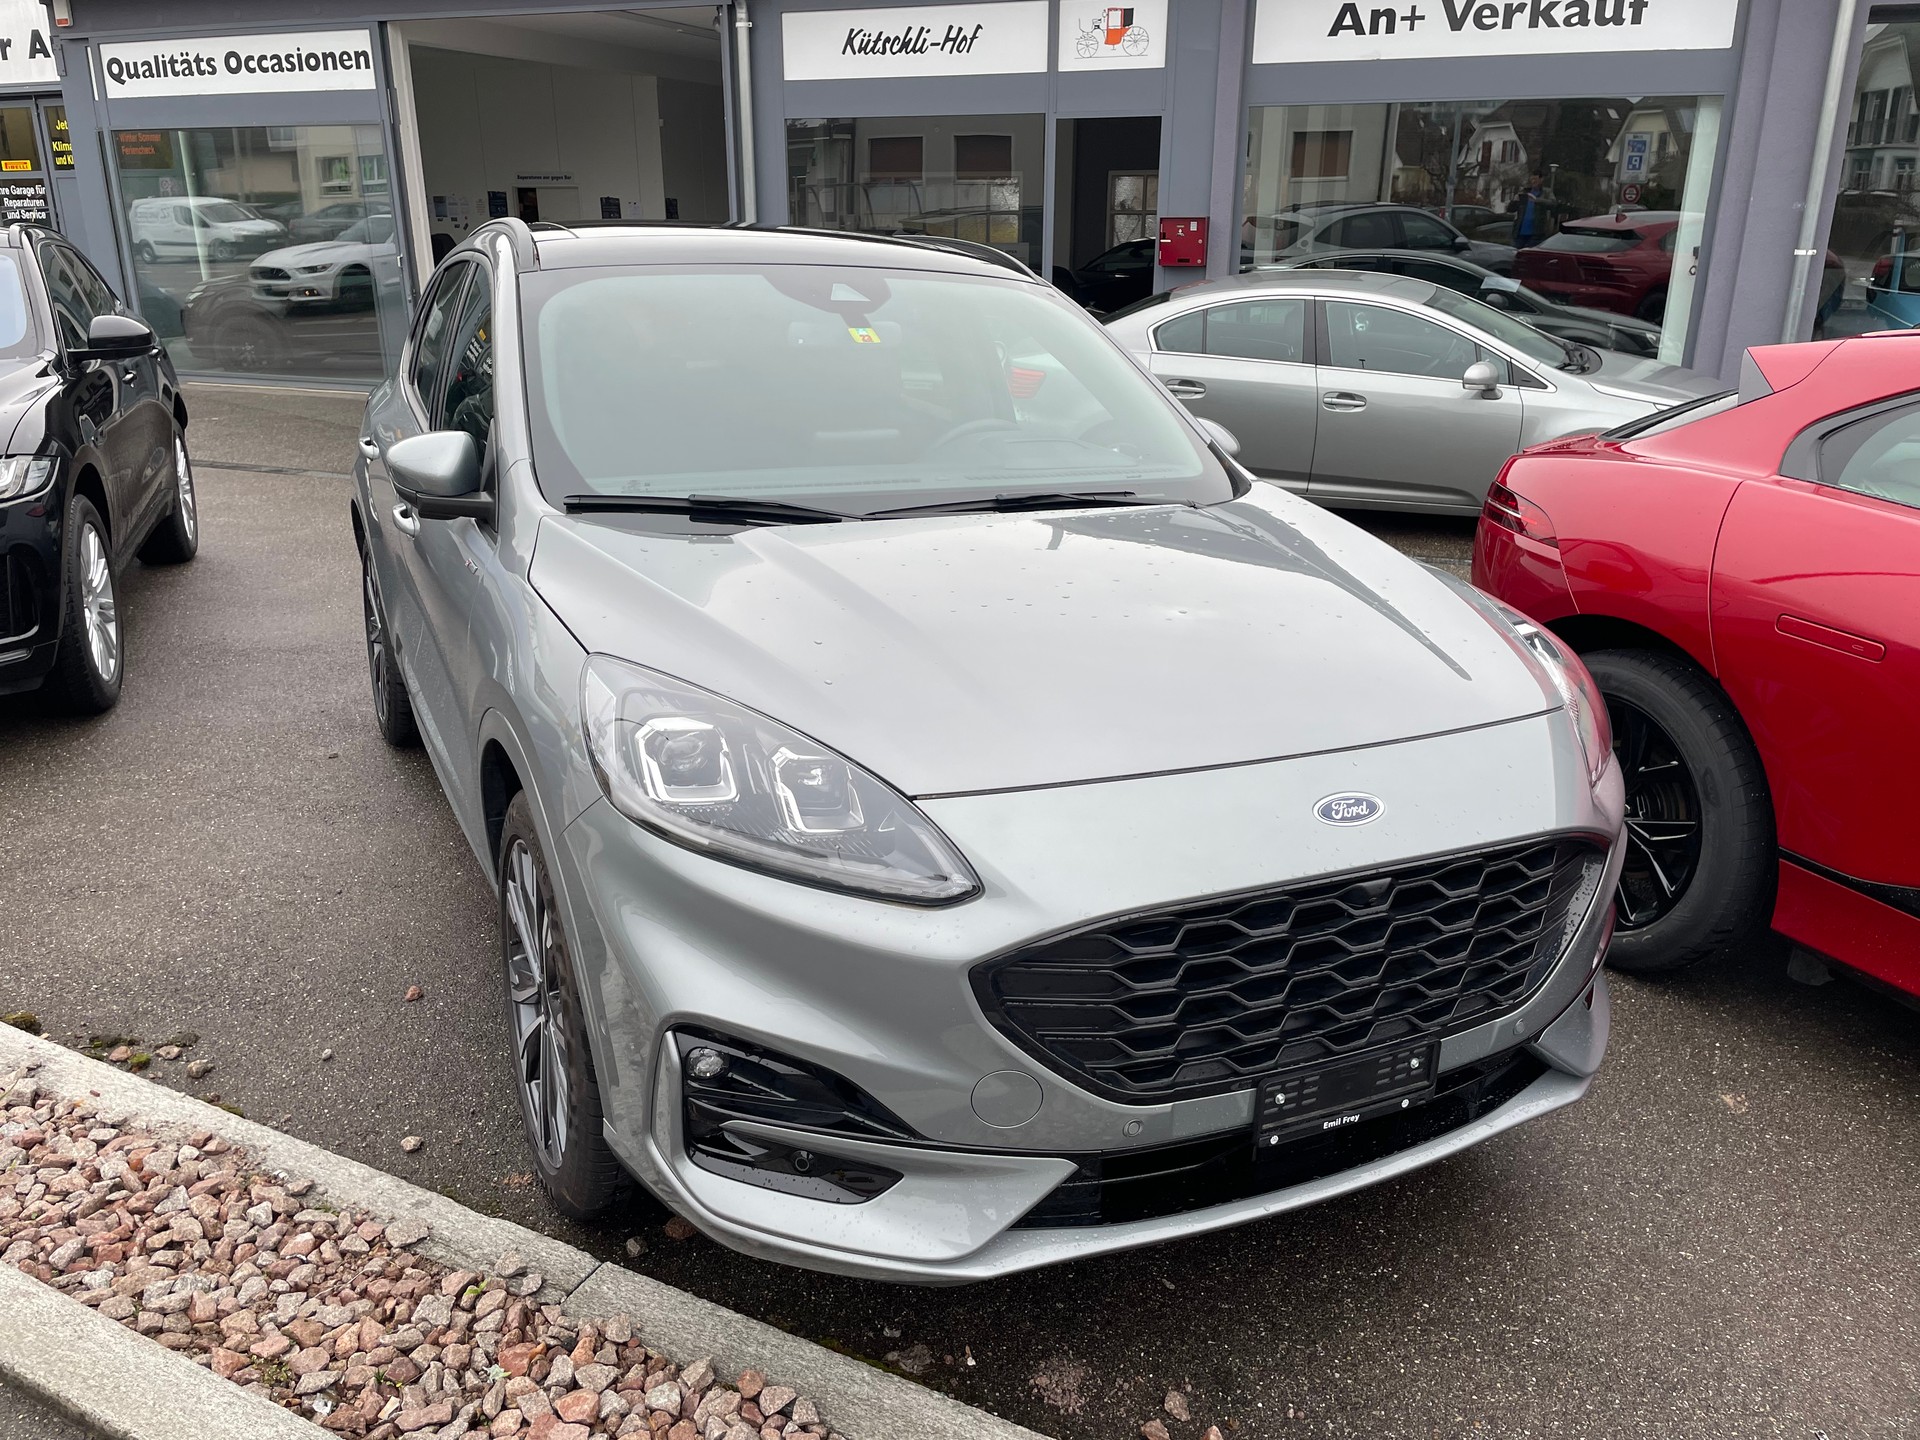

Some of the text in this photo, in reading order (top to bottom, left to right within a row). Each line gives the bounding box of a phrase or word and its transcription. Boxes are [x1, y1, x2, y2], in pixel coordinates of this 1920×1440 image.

[1327, 0, 1649, 37] An+ Verkauf
[841, 23, 983, 56] Kütschli-Hof
[106, 46, 371, 86] Qualitäts Occasionen
[55, 154, 67, 165] und
[10, 185, 35, 197] Garage
[35, 184, 46, 195] für
[3, 197, 45, 209] Reparaturen
[6, 209, 47, 220] und Service
[1331, 798, 1370, 820] Ford
[1323, 1114, 1360, 1130] Emil Frey
